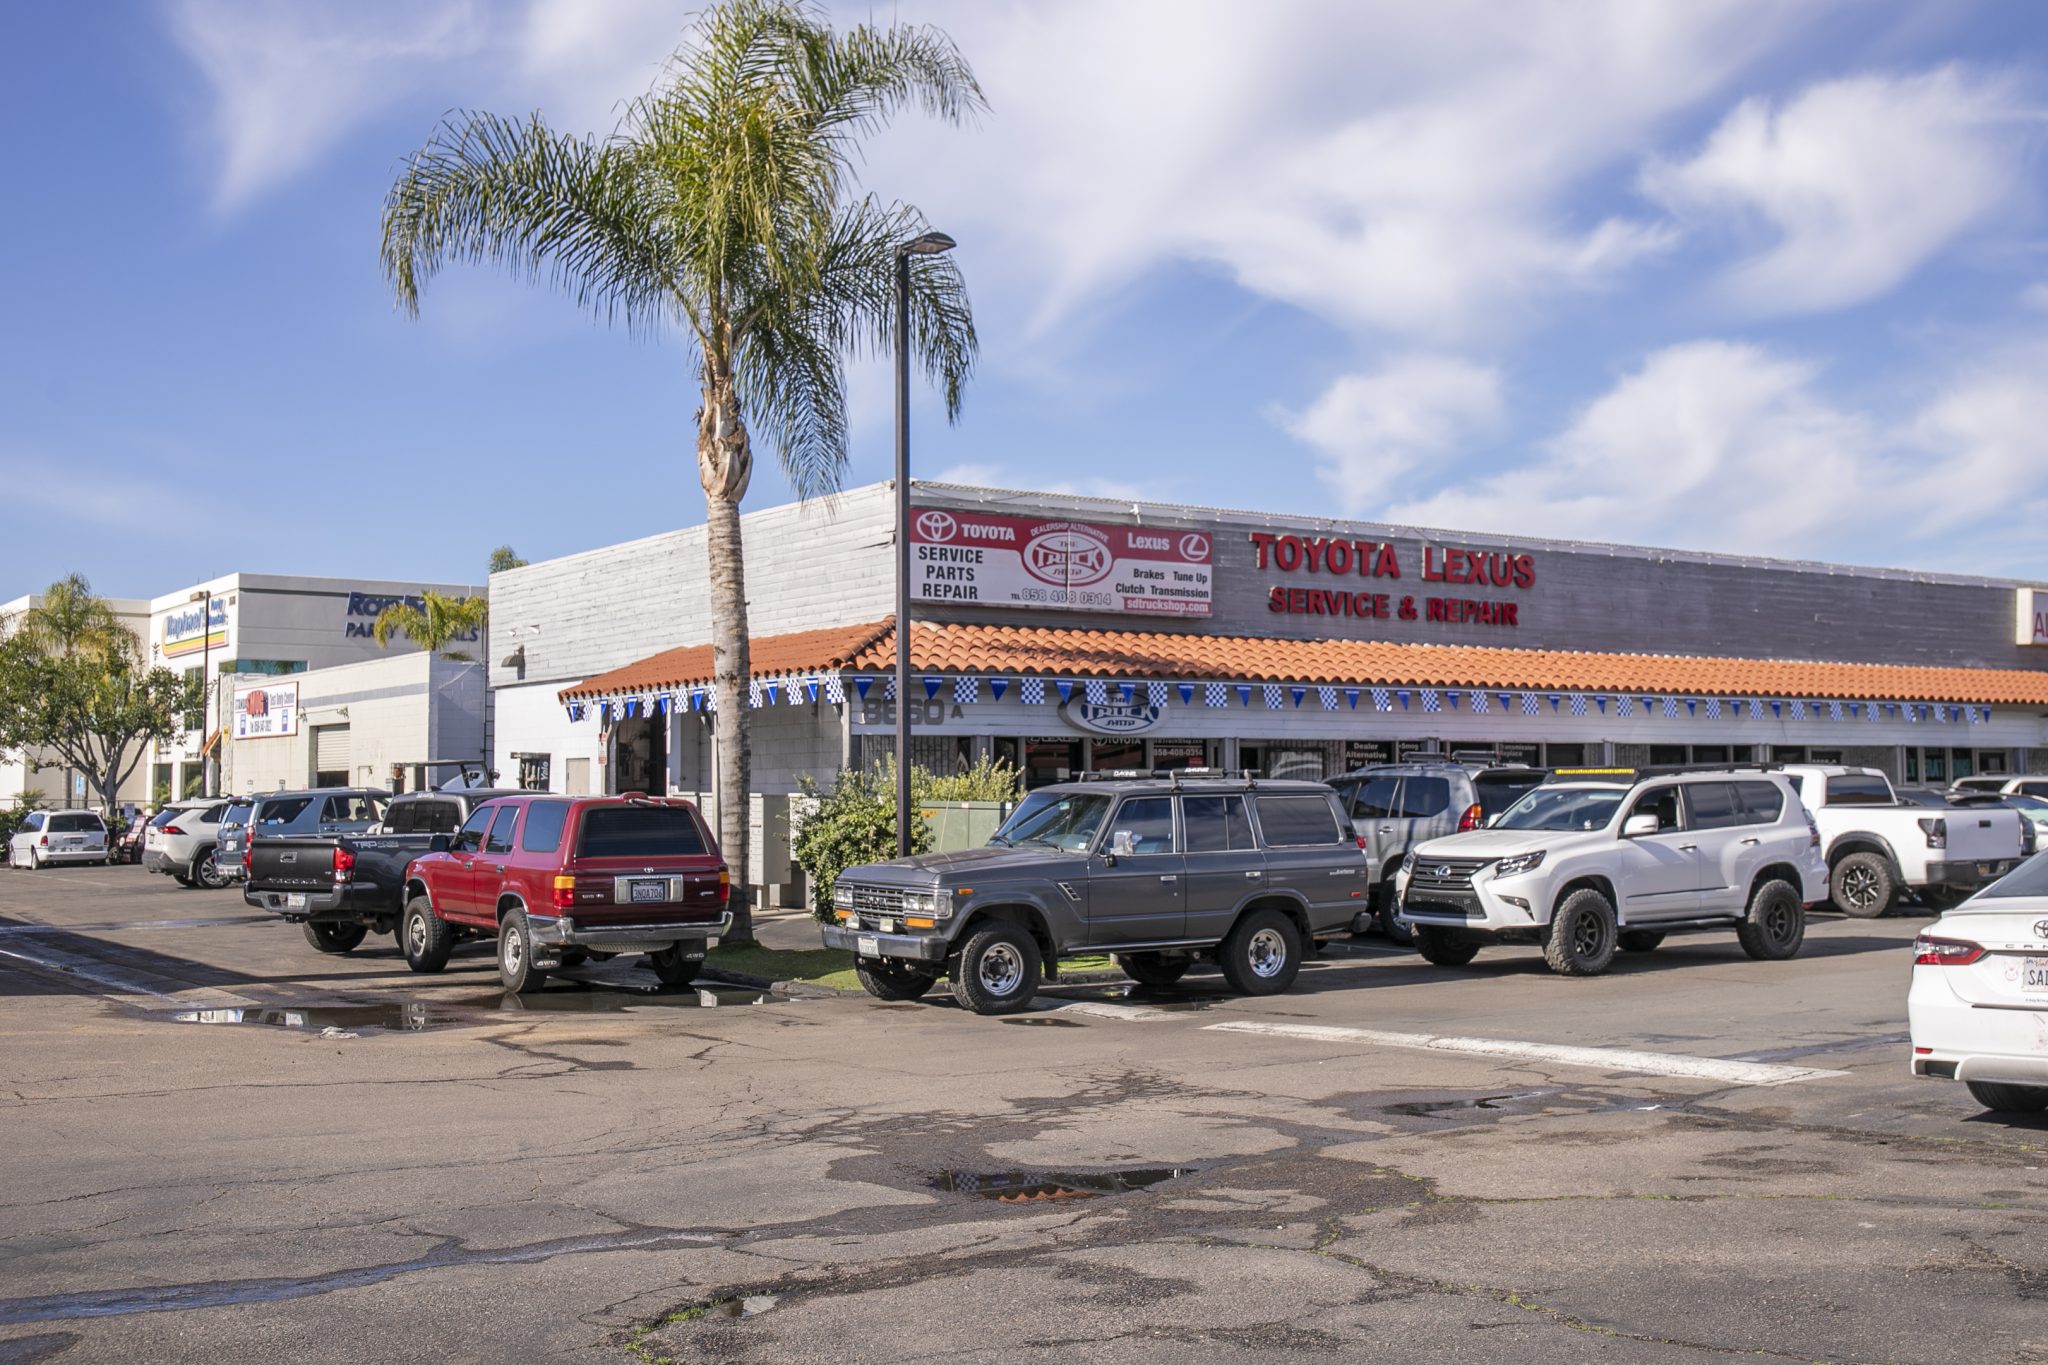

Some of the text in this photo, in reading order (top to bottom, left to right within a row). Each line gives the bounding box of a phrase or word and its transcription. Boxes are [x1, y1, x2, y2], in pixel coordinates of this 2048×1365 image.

[961, 524, 1015, 541] TOYOTA
[1030, 522, 1109, 543] DEALERSHIP ALTERNATIVE
[1128, 532, 1170, 551] Lexus
[918, 545, 983, 564] SERVICE
[1035, 546, 1102, 569] TRUCK
[1249, 532, 1536, 589] TOYOTA LEXUS
[926, 565, 975, 581] PARTS
[1133, 568, 1208, 584] Brakes Tune Up
[922, 583, 978, 600] REPAIR
[1022, 588, 1046, 601] 858
[1050, 590, 1076, 603] 408
[1080, 591, 1112, 605] 0314
[1115, 583, 1209, 599] Clutch Transmission
[1127, 599, 1209, 614] sdtruckshop.com
[1268, 585, 1518, 626] SERVICE & REPAIR
[950, 704, 964, 719] A
[1085, 703, 1157, 722] TRUCK
[1107, 737, 1141, 745] TOYOTA
[1353, 742, 1379, 750] Dealer
[1345, 751, 1388, 759] Alternative
[352, 840, 377, 849] TRD
[268, 877, 318, 886] TACOMA
